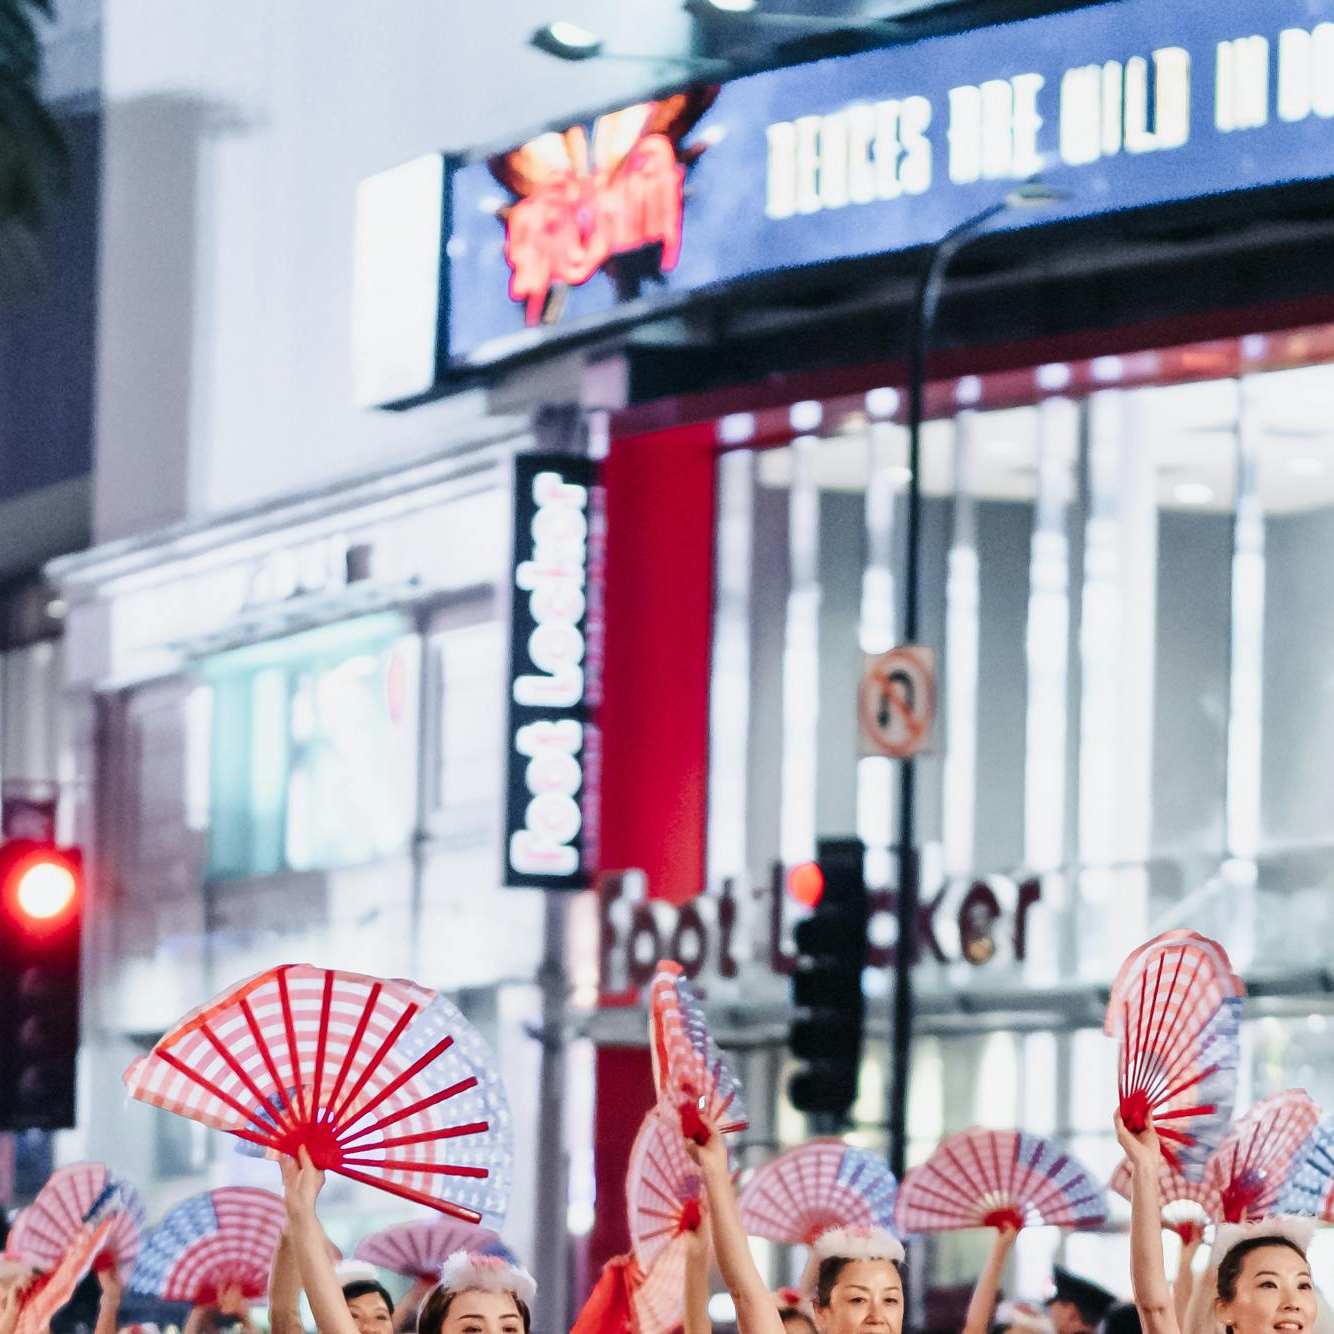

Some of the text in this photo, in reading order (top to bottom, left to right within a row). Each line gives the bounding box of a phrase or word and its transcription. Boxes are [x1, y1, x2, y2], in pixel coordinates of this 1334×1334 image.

[1060, 46, 1191, 166] WILD
[1215, 35, 1269, 133] IN
[510, 471, 589, 876] Foot Locker
